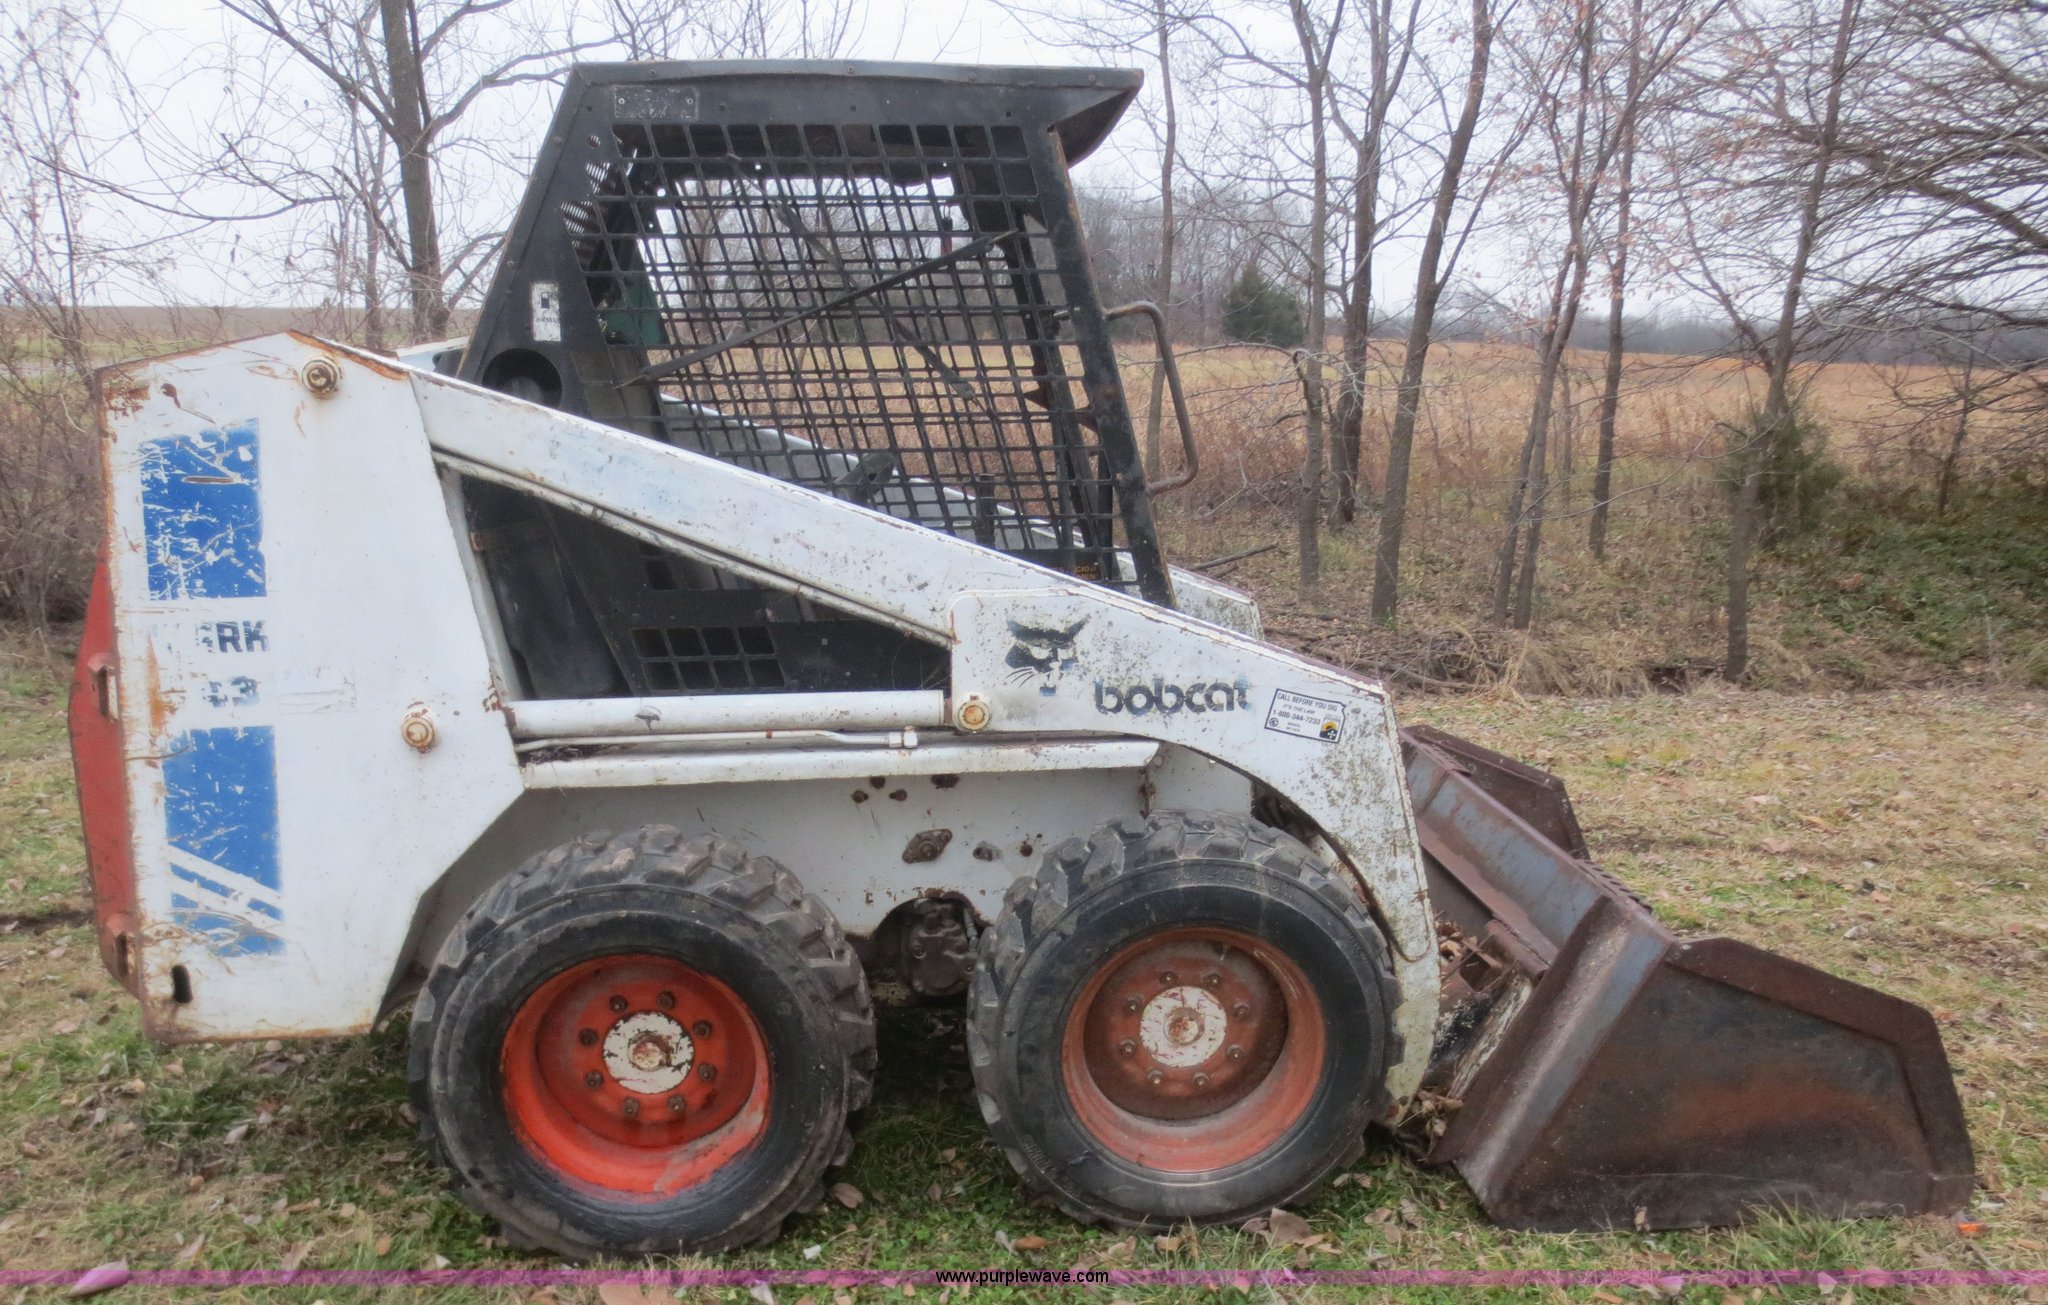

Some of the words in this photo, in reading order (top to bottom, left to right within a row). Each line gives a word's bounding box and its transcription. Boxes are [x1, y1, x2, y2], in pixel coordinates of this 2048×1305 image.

[1093, 674, 1252, 715] bobcat
[1277, 692, 1291, 702] CALL
[1292, 695, 1314, 707] BEFORE
[1315, 701, 1327, 710] YOU
[1327, 703, 1338, 712] DIG
[1273, 709, 1321, 725] 1-800-344-7233
